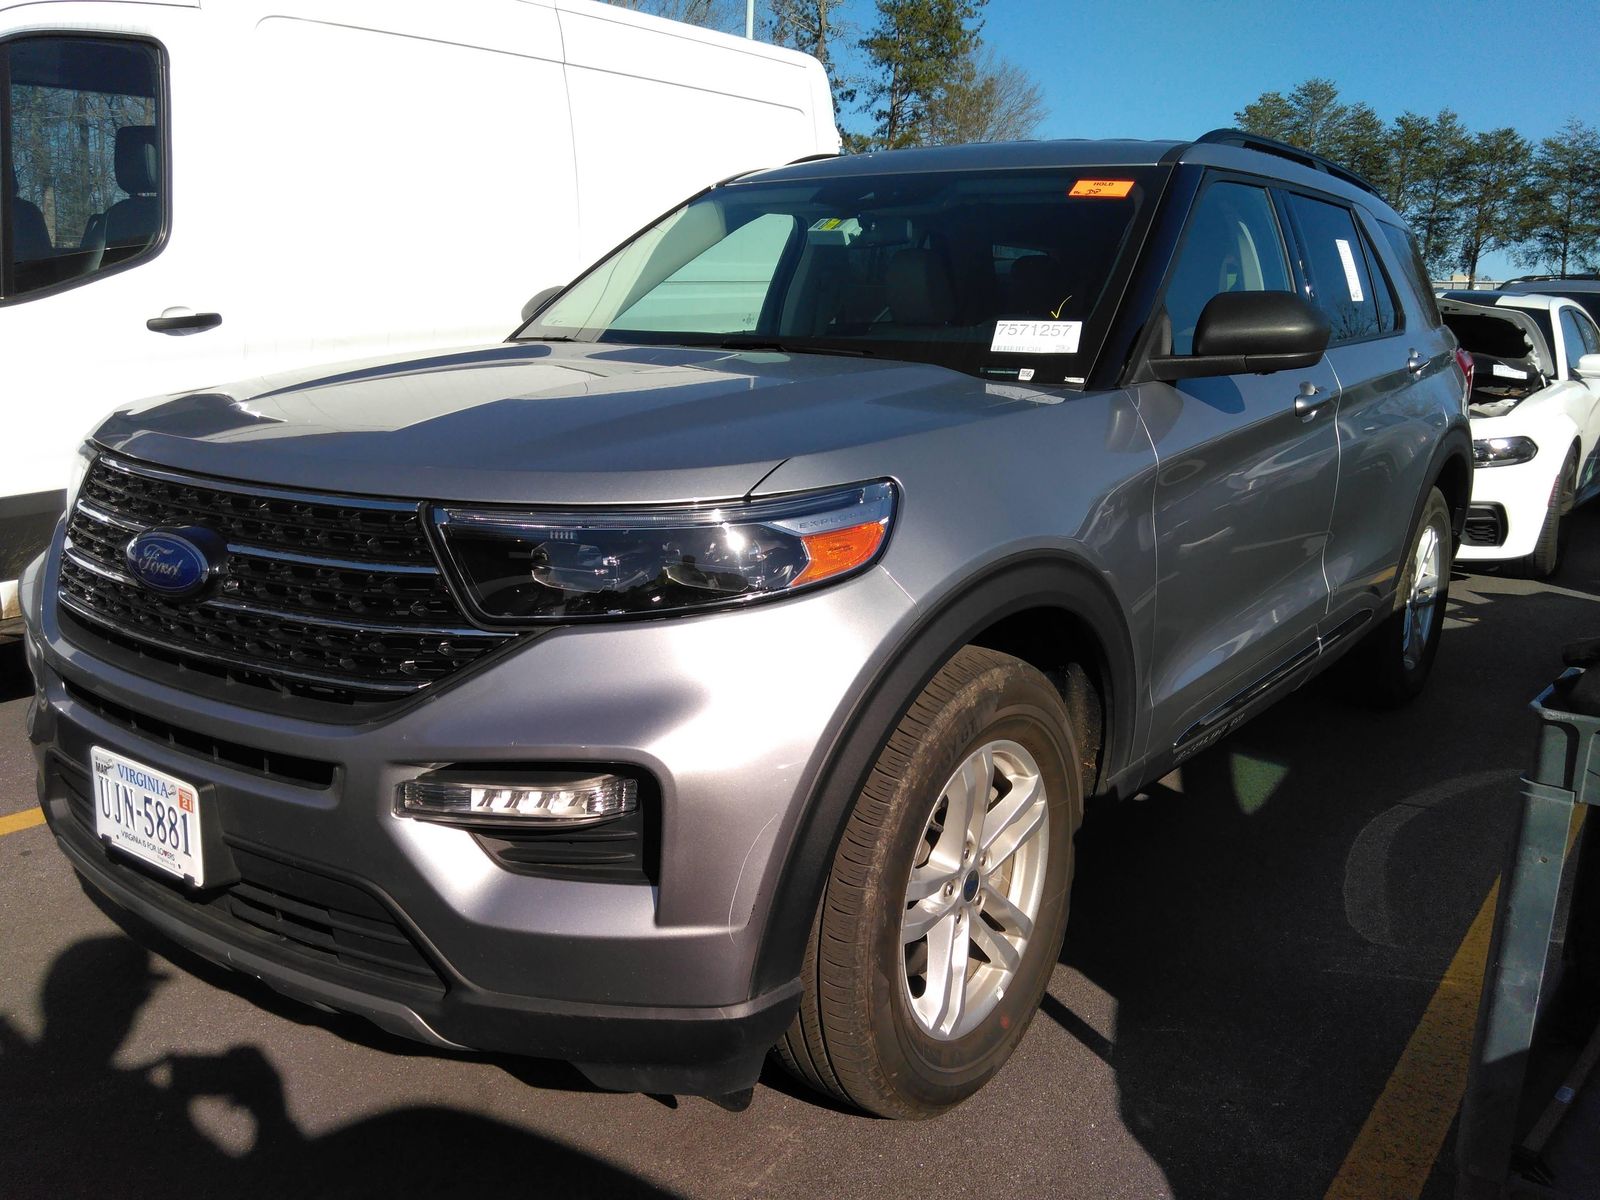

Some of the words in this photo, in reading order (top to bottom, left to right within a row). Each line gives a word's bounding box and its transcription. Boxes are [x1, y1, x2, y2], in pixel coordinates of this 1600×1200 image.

[998, 323, 1073, 337] 7571257
[139, 543, 183, 578] Ford
[117, 763, 170, 799] VIRGINIA
[98, 775, 192, 858] UJN-5881
[121, 830, 142, 846] VIRGINIA
